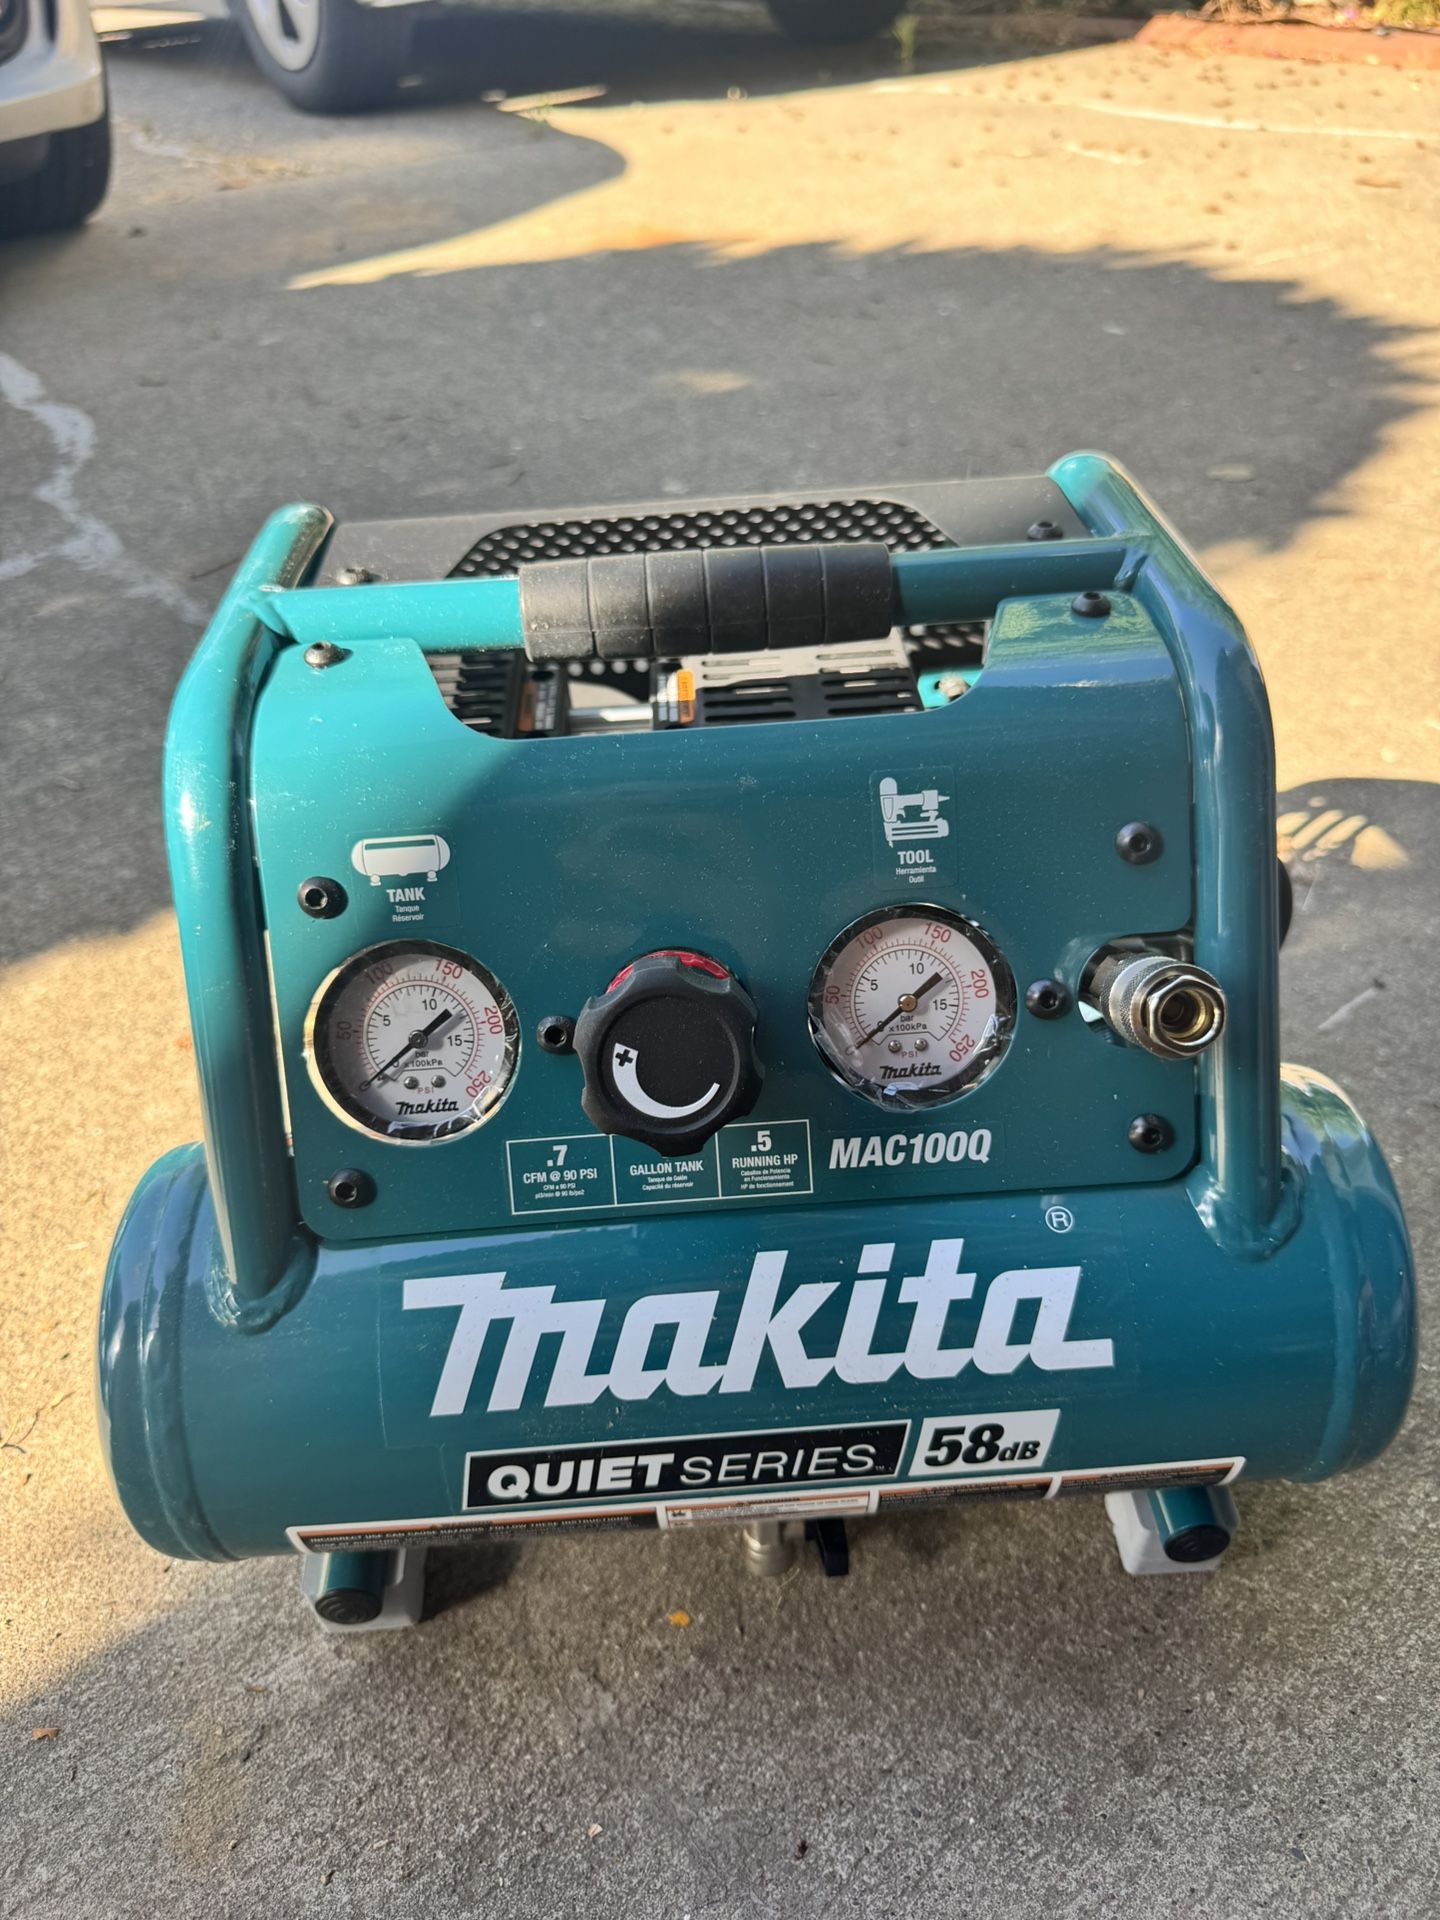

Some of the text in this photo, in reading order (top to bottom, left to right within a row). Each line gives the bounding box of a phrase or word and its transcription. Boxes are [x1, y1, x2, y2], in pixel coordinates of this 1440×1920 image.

[897, 849, 934, 865] TOOL
[895, 866, 937, 875] Herramienta
[908, 875, 925, 883] Outil
[386, 887, 426, 902] TANK
[394, 905, 420, 913] Tanque
[392, 913, 425, 922] Réservoir
[856, 926, 883, 949] 100
[924, 922, 952, 943] 150
[365, 962, 393, 984] 100
[434, 959, 464, 980] 150
[909, 962, 925, 974] 10
[870, 979, 878, 991] 5
[970, 969, 989, 999] 200
[825, 985, 840, 1005] 50
[422, 999, 438, 1010] 10
[932, 999, 947, 1010] 15
[383, 1015, 391, 1026] 5
[484, 1005, 503, 1035] 200
[336, 1020, 352, 1041] 50
[447, 1035, 463, 1047] 15
[949, 1033, 975, 1062] 250
[465, 1070, 491, 1098] 250
[751, 1130, 772, 1152] .5
[828, 1128, 992, 1169] MAC100Q
[546, 1144, 568, 1167] .7
[732, 1154, 798, 1168] RUNNING HP
[523, 1168, 598, 1184] CFM @ 90 PSI
[630, 1160, 704, 1176] GALLON TANK
[487, 1453, 675, 1500] QUIET
[680, 1444, 877, 1485] SERIES
